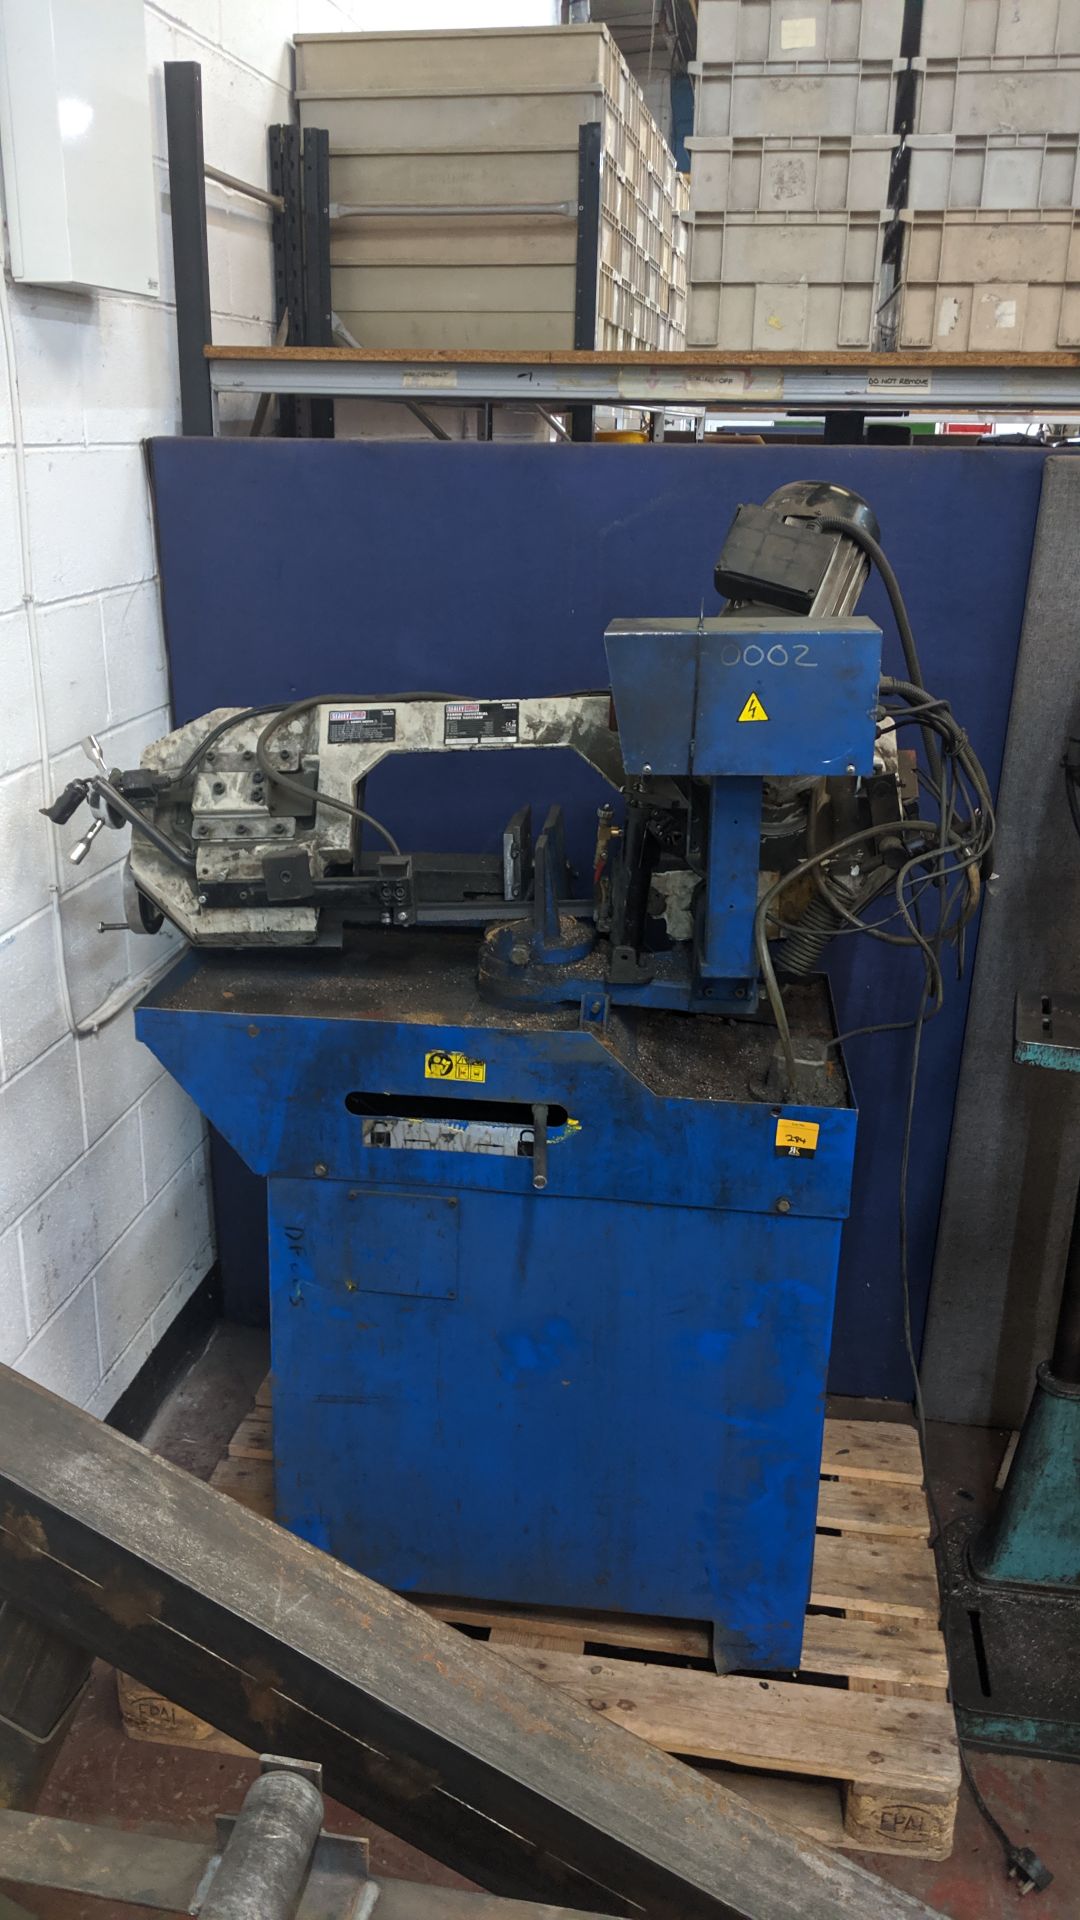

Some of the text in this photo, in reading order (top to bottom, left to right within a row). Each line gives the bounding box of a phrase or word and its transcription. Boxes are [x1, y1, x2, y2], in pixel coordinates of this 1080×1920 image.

[868, 377, 879, 385] DO
[881, 377, 897, 385] NOT
[721, 644, 818, 666] 0002
